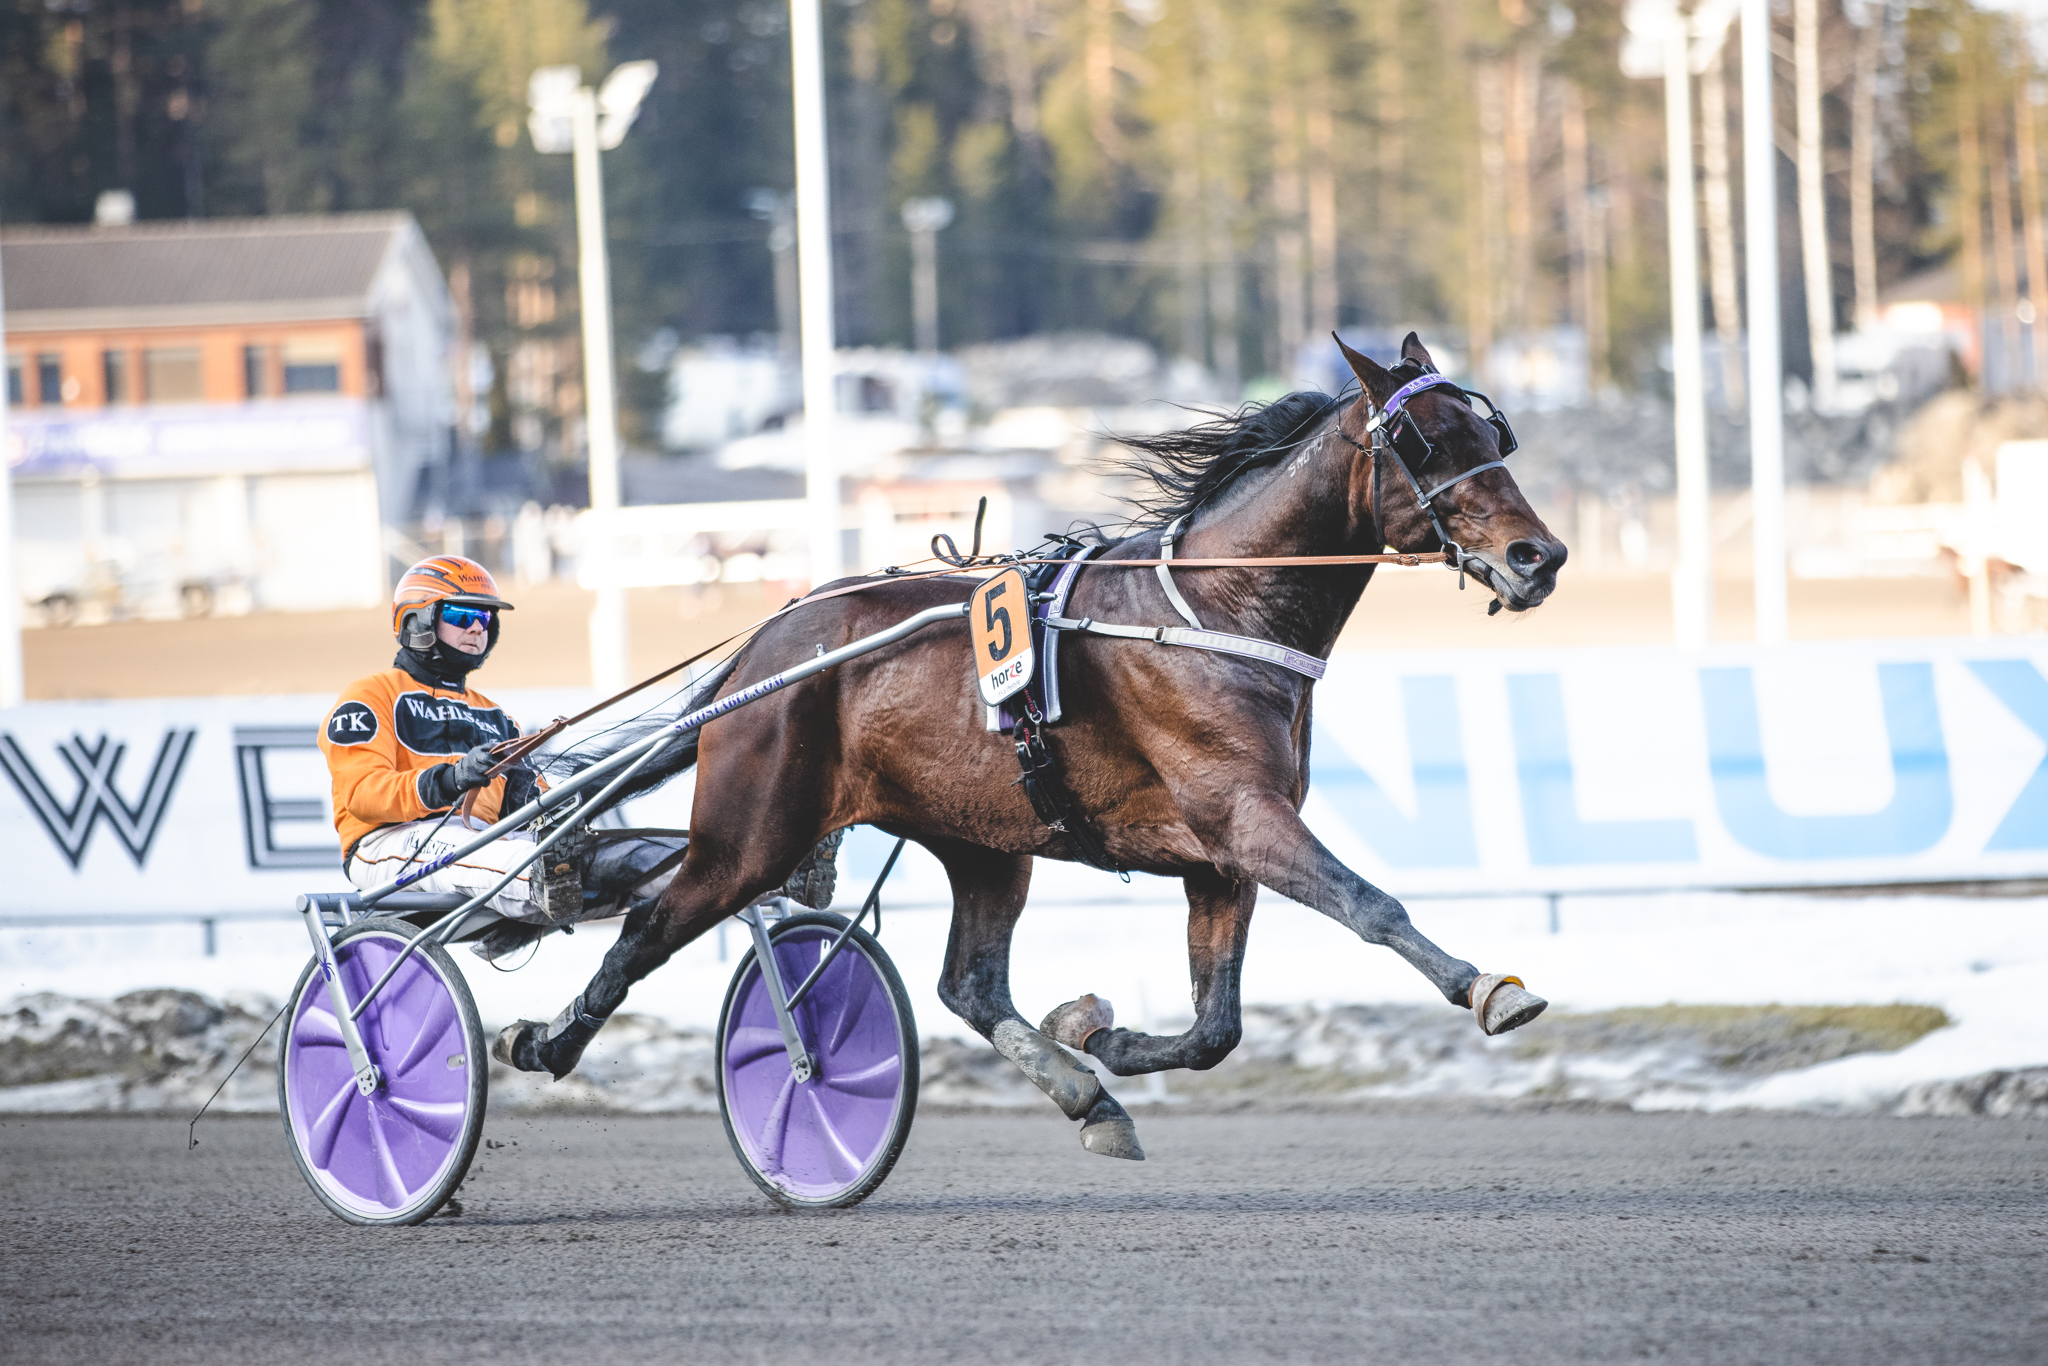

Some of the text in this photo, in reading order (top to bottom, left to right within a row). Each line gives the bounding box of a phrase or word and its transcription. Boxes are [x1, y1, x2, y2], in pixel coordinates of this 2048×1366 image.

[985, 581, 1012, 661] 5
[991, 661, 1023, 690] horze
[332, 711, 371, 732] TK
